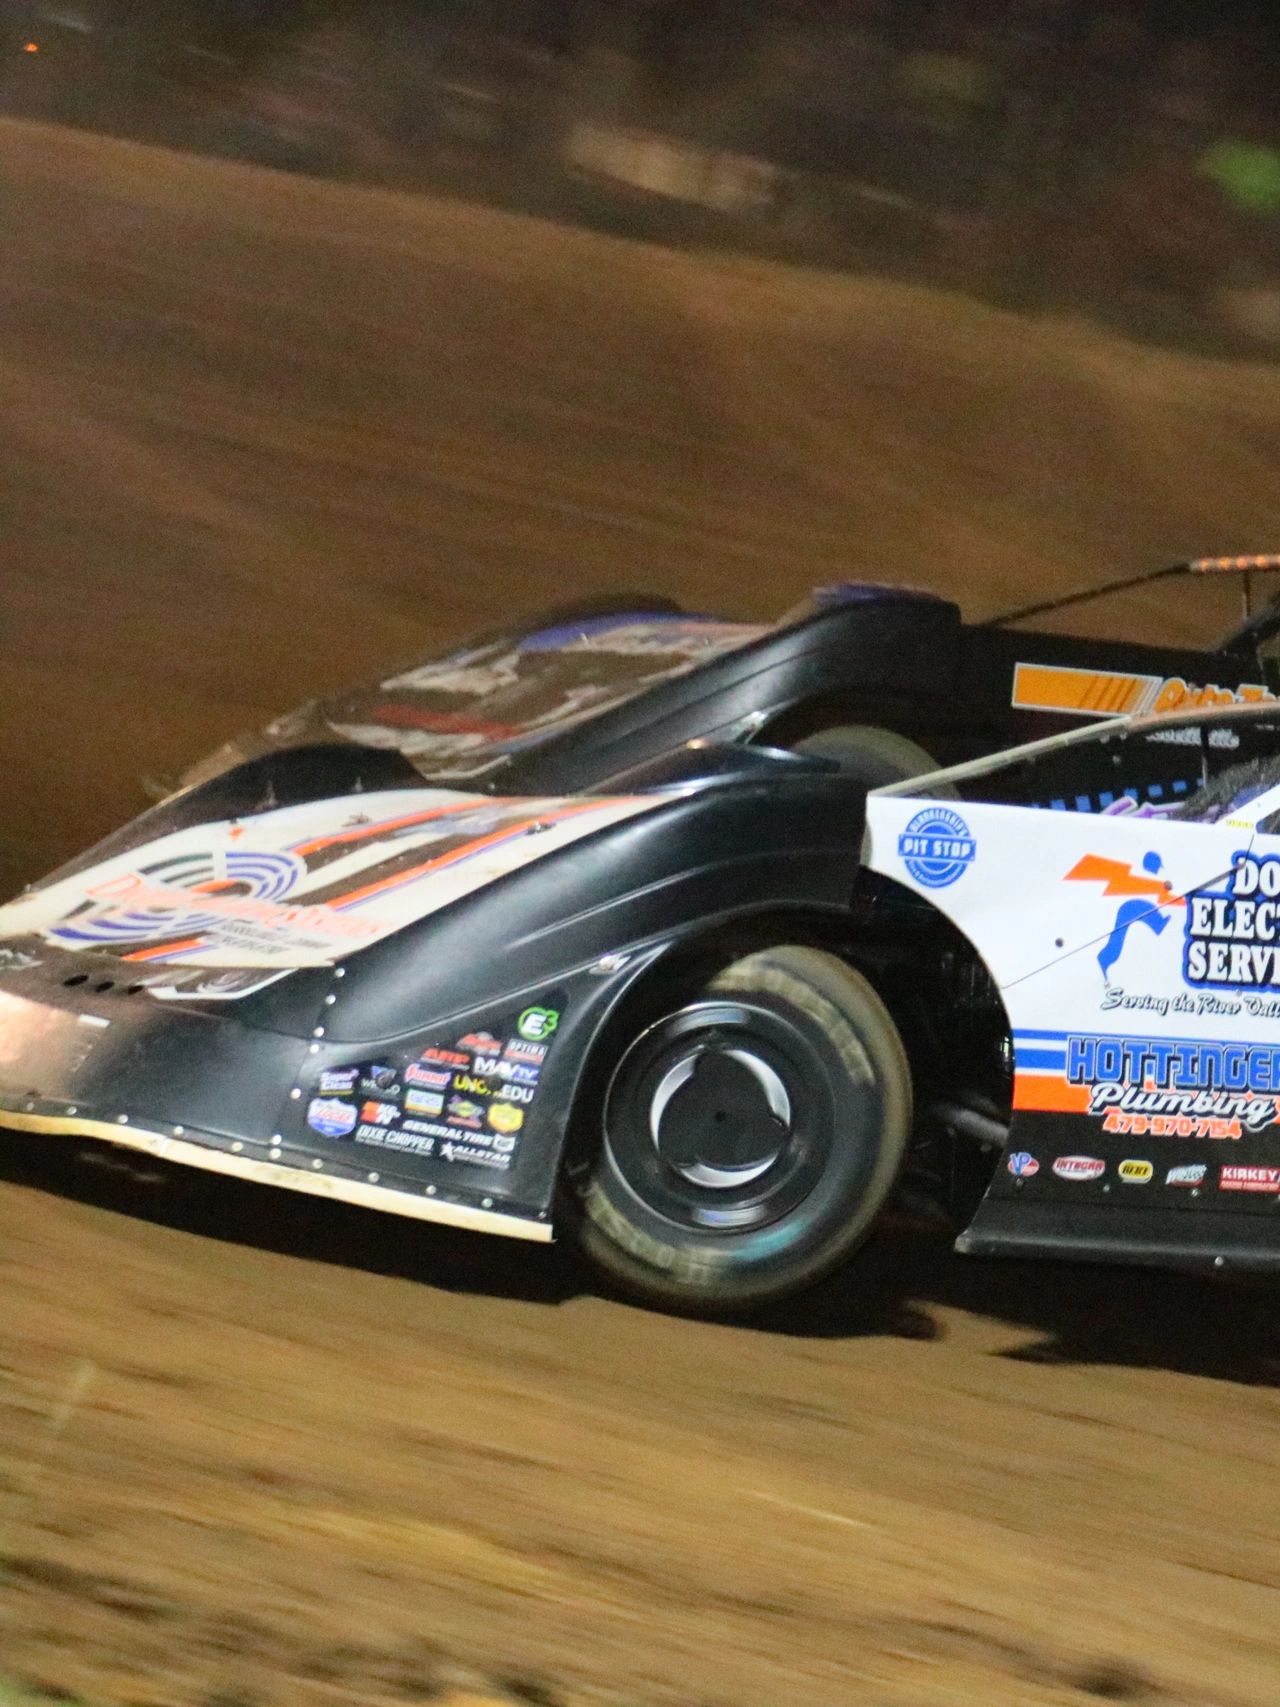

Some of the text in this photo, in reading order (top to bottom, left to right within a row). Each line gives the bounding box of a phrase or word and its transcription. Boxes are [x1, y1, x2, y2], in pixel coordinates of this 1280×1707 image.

[904, 837, 971, 858] PIT STOP
[1101, 987, 1169, 1016] Serving
[1171, 991, 1195, 1013] the
[1198, 993, 1241, 1016] River
[1091, 1081, 1277, 1127] Plumbing
[1102, 1113, 1243, 1139] 479-970-7154
[1222, 1167, 1279, 1182] KIRKEY
